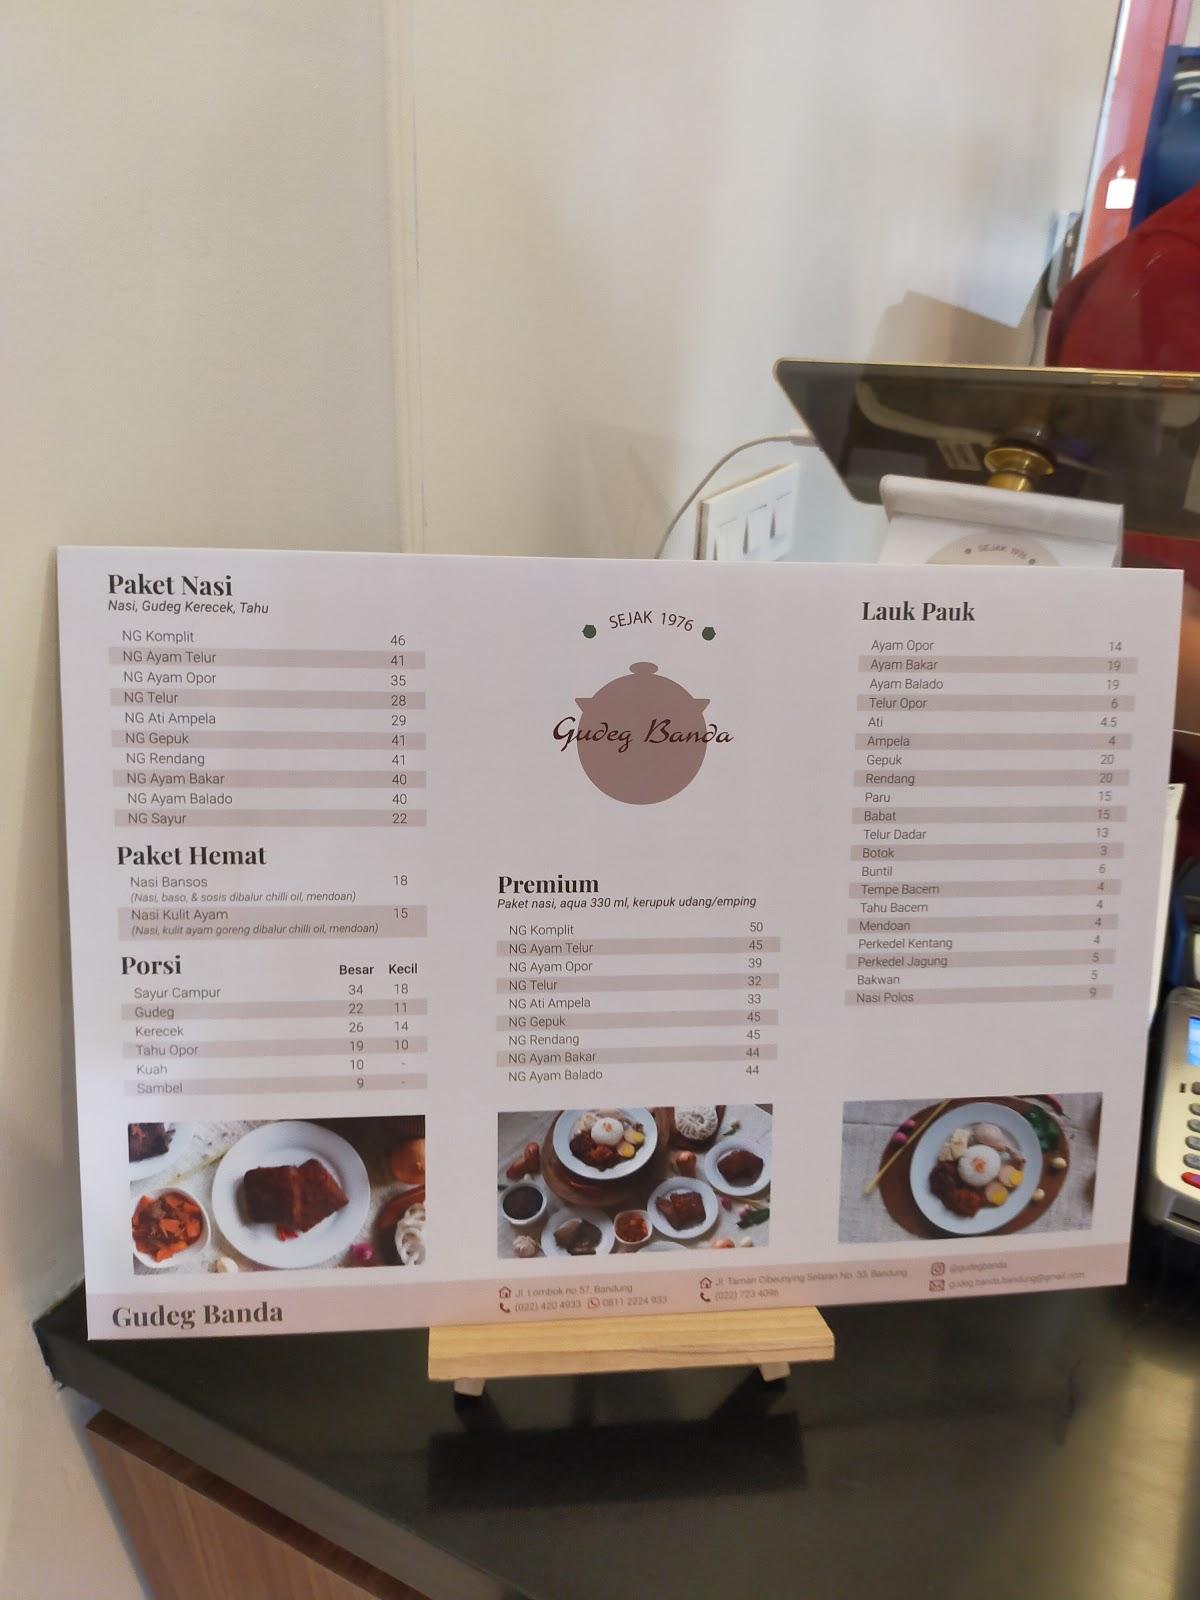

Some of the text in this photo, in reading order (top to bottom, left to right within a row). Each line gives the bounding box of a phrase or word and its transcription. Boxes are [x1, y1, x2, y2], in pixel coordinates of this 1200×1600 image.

[108, 573, 232, 596] Paket Nasi
[108, 600, 269, 614] Nasi, Gudeg Kerecek, Tahu
[862, 601, 975, 621] Lauk Pauk
[609, 610, 694, 631] SEJAK 1976
[122, 630, 405, 646] NG Komplit 46
[871, 640, 1122, 653] Ayam Opor 14
[123, 650, 403, 666] NG Ayam Telur 41
[870, 659, 1121, 672] Ayam Bakar 19
[869, 678, 1120, 691] Ayam Balado 19
[124, 691, 406, 707] NG Telur 28
[869, 697, 1118, 711] Telur Opor 6
[125, 712, 406, 727] NG Ati Ampela 29
[868, 716, 1117, 728] Ati 4.5
[125, 732, 404, 746] NG Gepuk 41
[552, 716, 734, 753] Gudeg Banda
[866, 736, 1116, 749] Ampela 4
[126, 752, 404, 767] NG Rendang 41
[867, 754, 1115, 767] Gepuk 20
[866, 772, 1113, 786] Rendang 20
[865, 792, 890, 803] Paru
[128, 812, 407, 826] NG Sayur 22
[864, 810, 896, 821] Babat
[864, 829, 926, 840] Telur Dadar
[118, 845, 266, 865] Paket Hemat
[862, 848, 894, 858] Botok
[862, 866, 893, 877] Buntil
[130, 875, 407, 888] Nasi Bansos 18
[499, 874, 598, 894] Premium
[201, 892, 227, 902] sosis
[229, 892, 263, 902] dibalur
[265, 892, 288, 902] chilli
[306, 891, 356, 903] mendoan)
[861, 884, 940, 897] Tempe Bacem
[497, 896, 756, 911] Paket nasi, aqua 330 ml, kerupuk udang/emping
[860, 902, 928, 913] Tahu Bacem
[131, 907, 408, 923] Nasi Kulit Ayam 15
[162, 925, 183, 935] kulit
[185, 927, 213, 936] ayam
[215, 926, 250, 937] goreng
[252, 924, 287, 934] dibalur
[289, 924, 311, 934] chilli
[329, 923, 378, 934] mendoan)
[510, 922, 763, 937] NG Komplit 50
[859, 920, 910, 931] Mendoan
[509, 940, 763, 956] NG Ayam Telur 45
[858, 938, 953, 950] Perkedel Kentang
[122, 955, 417, 975] Porsi Besar Kecil
[858, 956, 948, 968] Perkedel Jagung
[857, 975, 900, 985] Bakwan
[134, 983, 408, 1001] Sayur Campur 34 18
[857, 992, 914, 1003] Nasi Polos
[509, 994, 761, 1010] NG Ati Ampela 33
[135, 1002, 406, 1020] Gudeg 22 11
[509, 1011, 761, 1029] NG Gepuk 45
[135, 1021, 408, 1037] Kerecek 26 14
[509, 1029, 760, 1047] NG Rendang 45
[136, 1039, 408, 1057] Tahu Opor 19 10
[137, 1059, 364, 1075] Kuah 10
[137, 1078, 364, 1094] Sambel 9
[112, 1301, 282, 1329] Gudeg Banda
